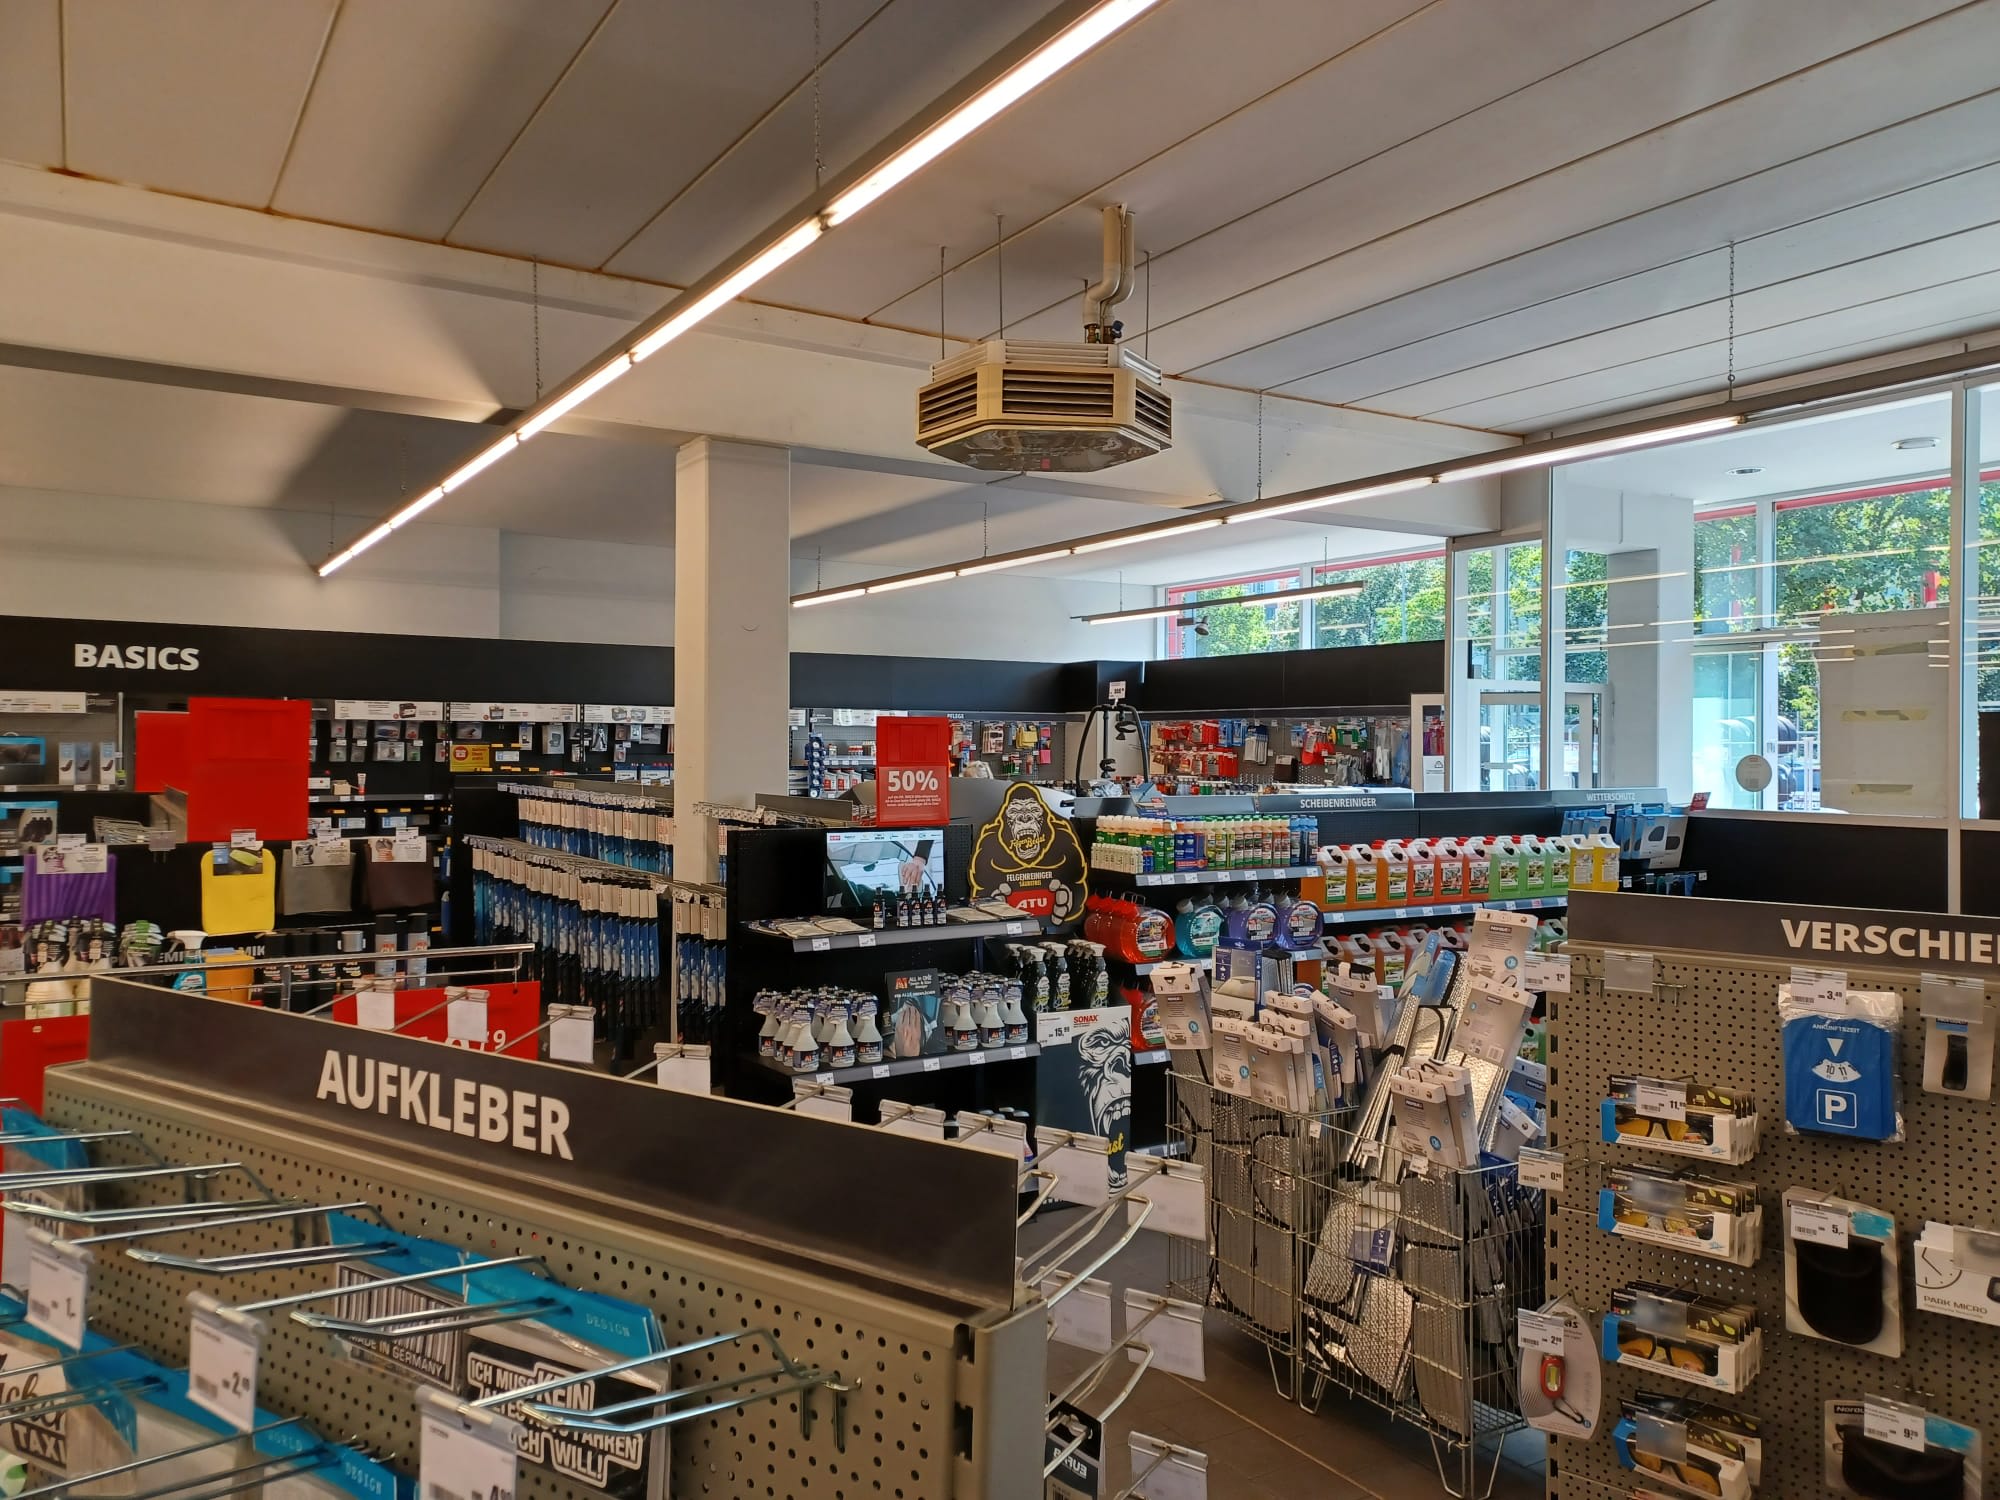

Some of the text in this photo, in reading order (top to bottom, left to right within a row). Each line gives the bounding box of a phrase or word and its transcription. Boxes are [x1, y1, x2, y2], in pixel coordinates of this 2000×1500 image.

[75, 643, 200, 671] BASICS
[888, 770, 939, 792] 50%
[1300, 798, 1376, 809] SCHEIBENREINIGER
[1586, 792, 1636, 801] WETTERSCHUTZ
[1006, 871, 1053, 882] FELGENREINIGER
[1015, 897, 1048, 909] ATU
[1780, 919, 2000, 965] VERSCHIE
[1073, 1014, 1099, 1024] SONAX
[1812, 1023, 1860, 1034] ANKUNFTSZEIT
[1825, 1064, 1848, 1076] 10 11
[316, 1050, 574, 1160] AUFKLEBER
[1825, 1094, 1847, 1120] P
[1923, 1295, 1951, 1307] PARK
[1953, 1301, 1988, 1314] MICRO
[586, 1313, 630, 1337] DESIGN
[351, 1335, 390, 1355] MADE IN
[392, 1344, 445, 1380] GERMANY
[471, 1359, 493, 1385] ICH
[536, 1369, 591, 1411] KEIN
[15, 1428, 67, 1466] TAXI
[555, 1439, 603, 1480] WILL!
[344, 1461, 382, 1496] DESIGN
